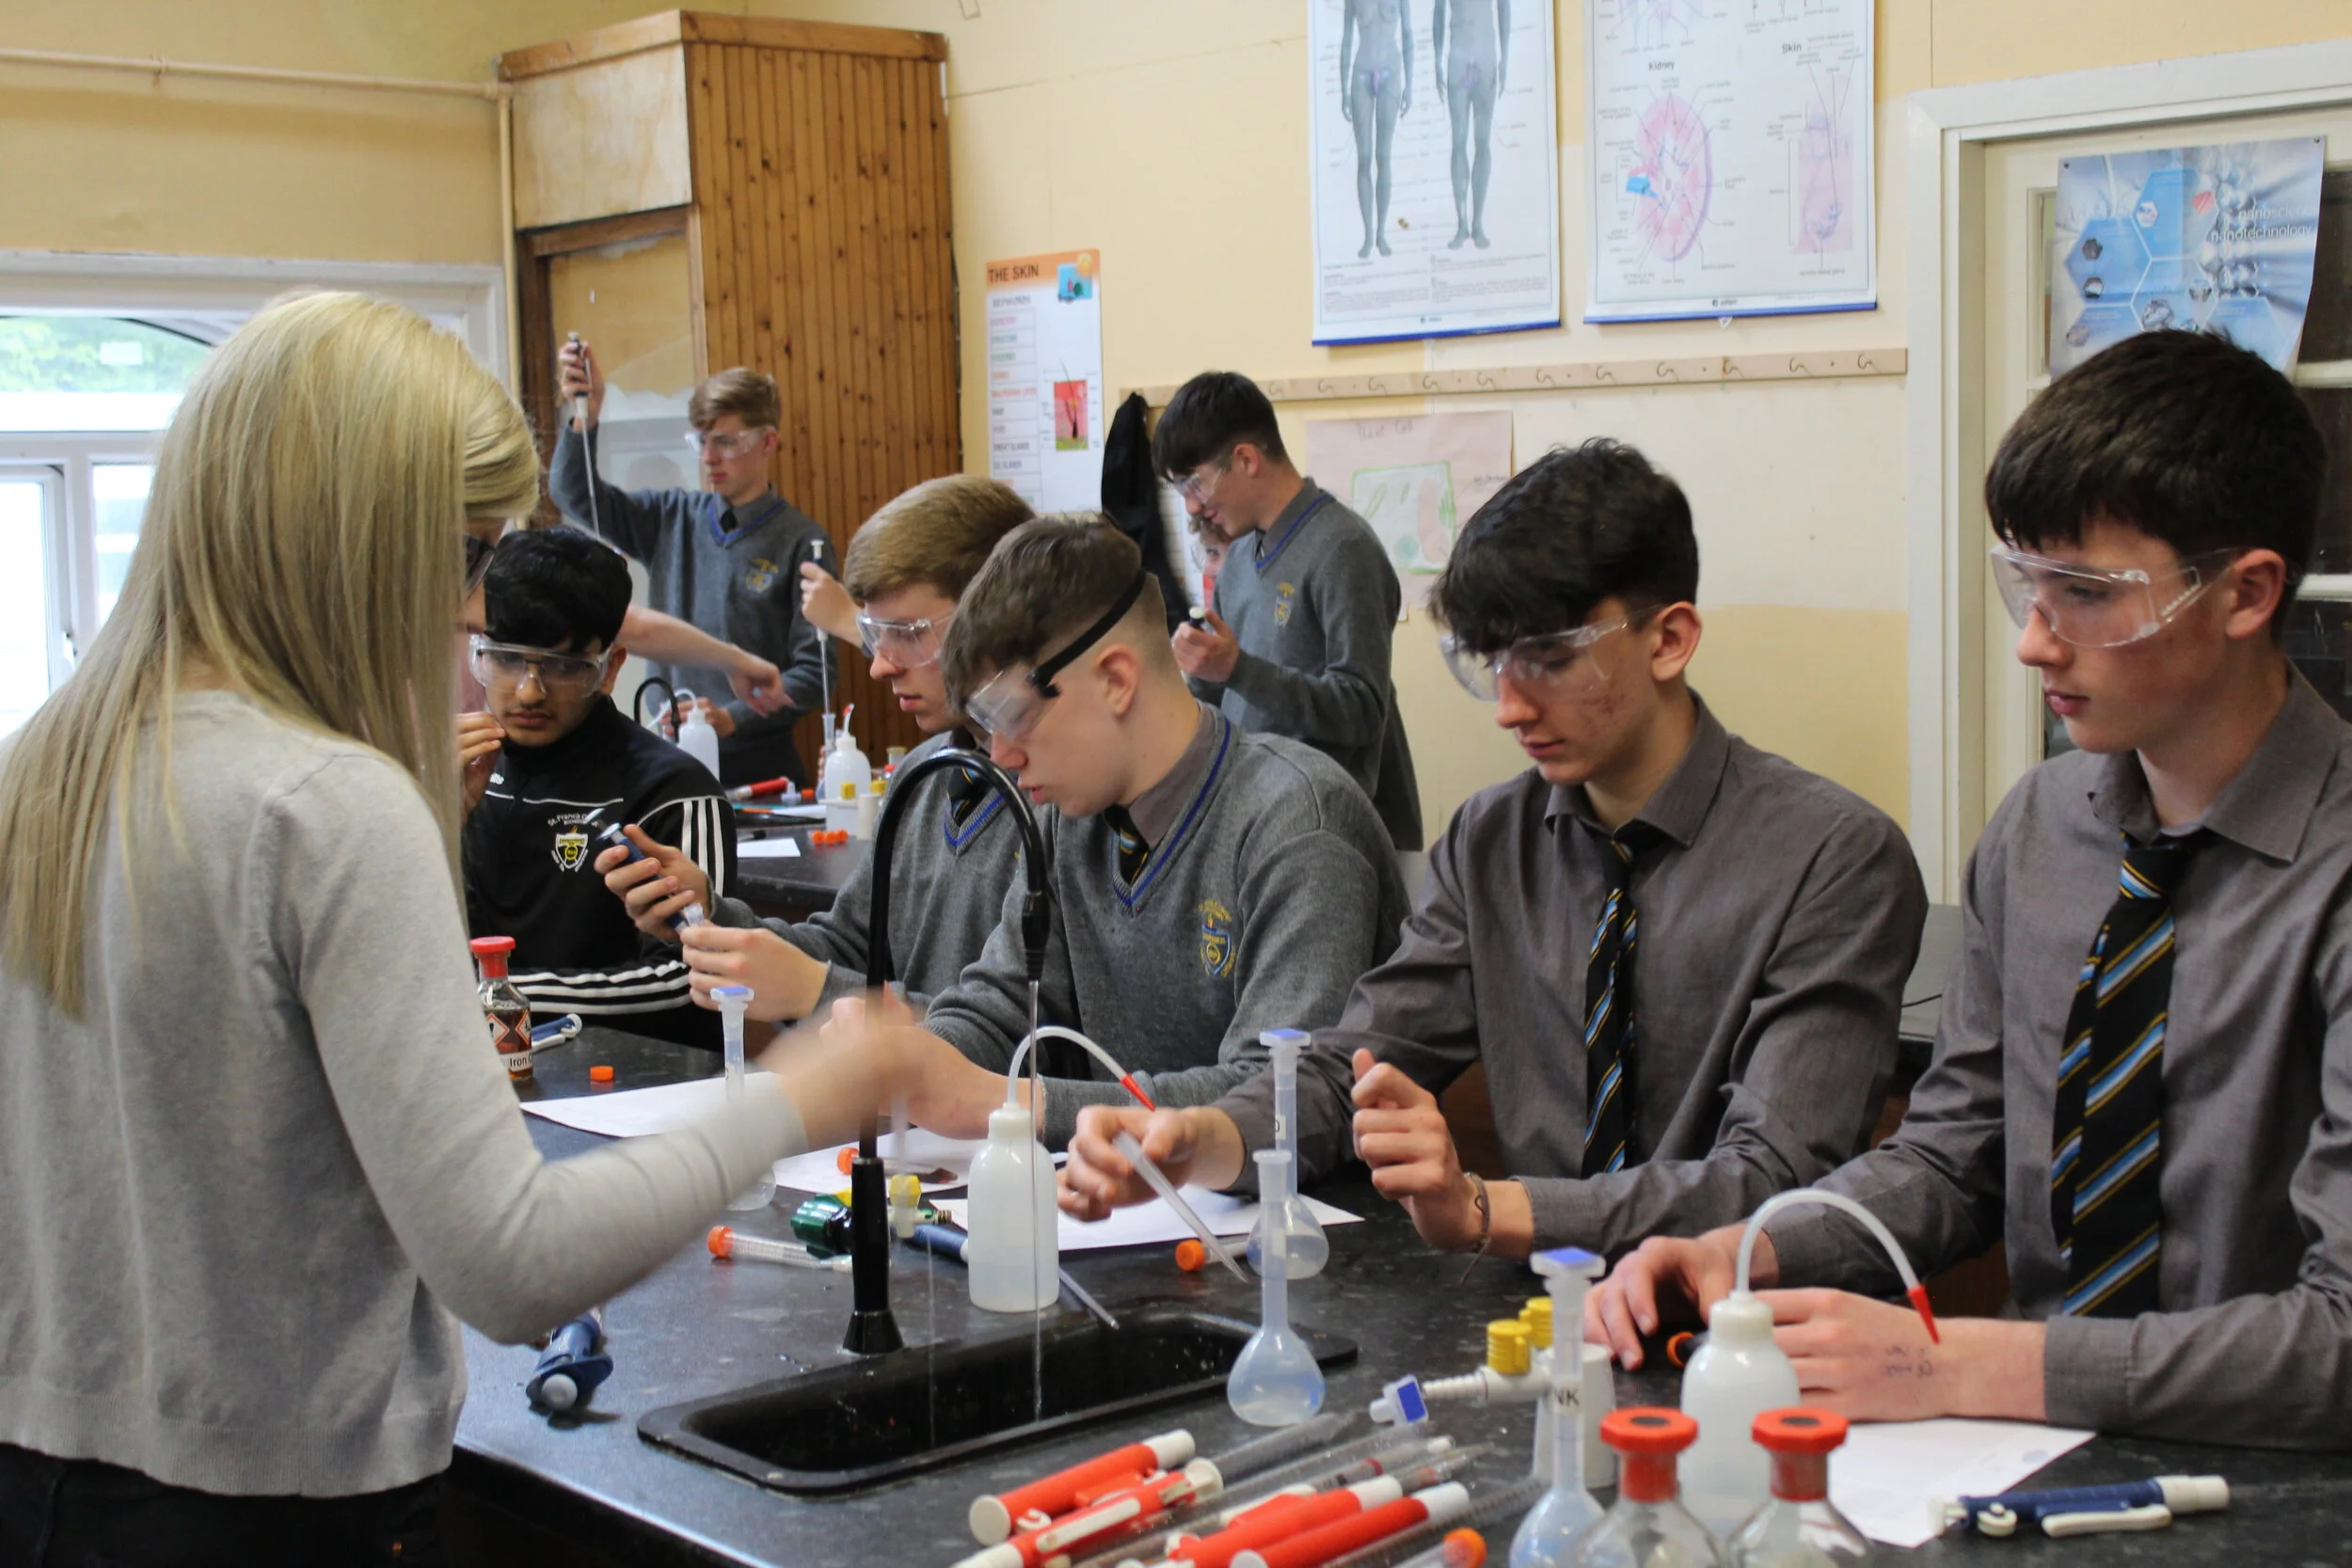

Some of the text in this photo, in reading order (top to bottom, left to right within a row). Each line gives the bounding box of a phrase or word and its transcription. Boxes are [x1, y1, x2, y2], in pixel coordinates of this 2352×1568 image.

[1782, 42, 1803, 54] Skin
[1648, 60, 1676, 71] Kidney
[2240, 203, 2310, 219] nanoscien
[988, 264, 1039, 284] THE SKIN
[510, 1056, 528, 1068] Iron
